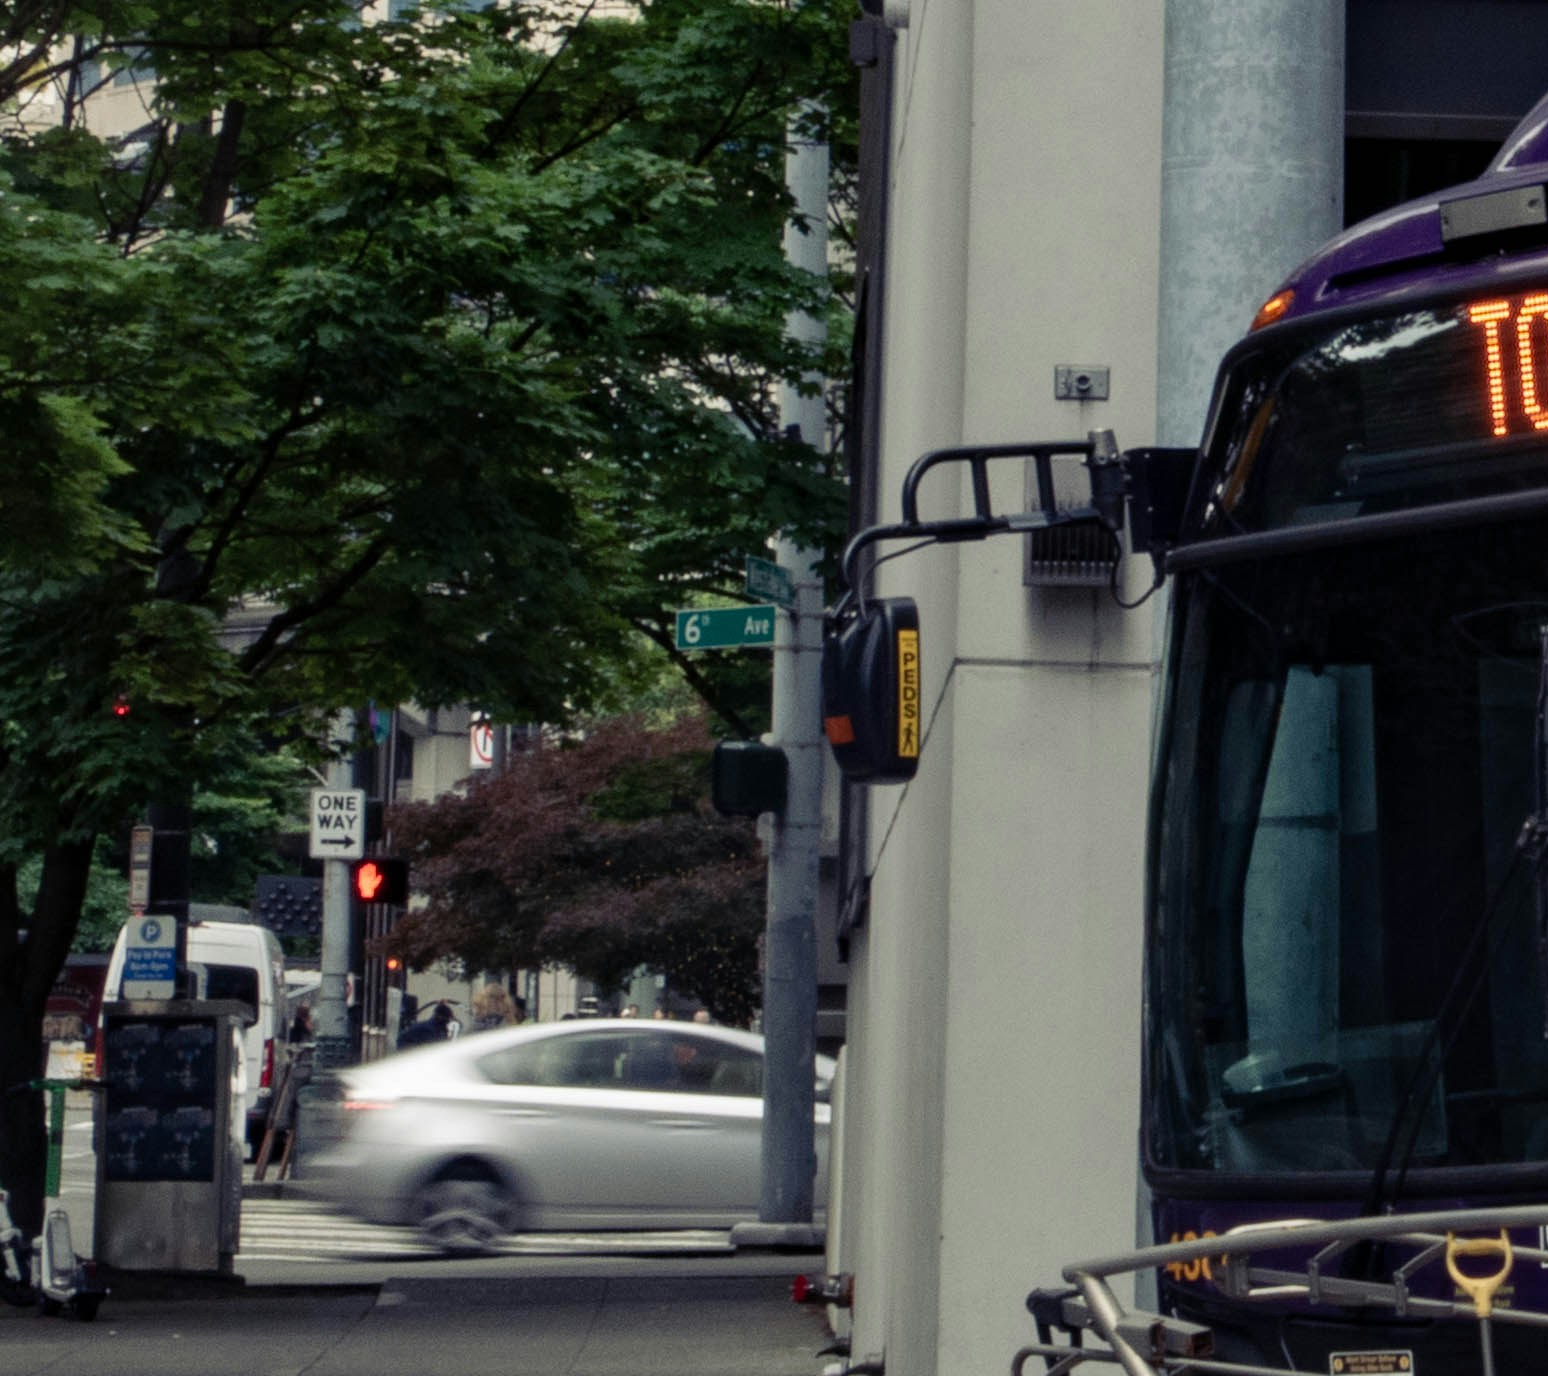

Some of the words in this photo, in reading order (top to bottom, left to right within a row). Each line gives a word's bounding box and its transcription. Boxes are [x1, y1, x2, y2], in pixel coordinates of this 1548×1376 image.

[744, 615, 770, 635] Ave
[903, 652, 917, 720] PEDS
[318, 795, 358, 811] ONE
[318, 814, 358, 831] WAY
